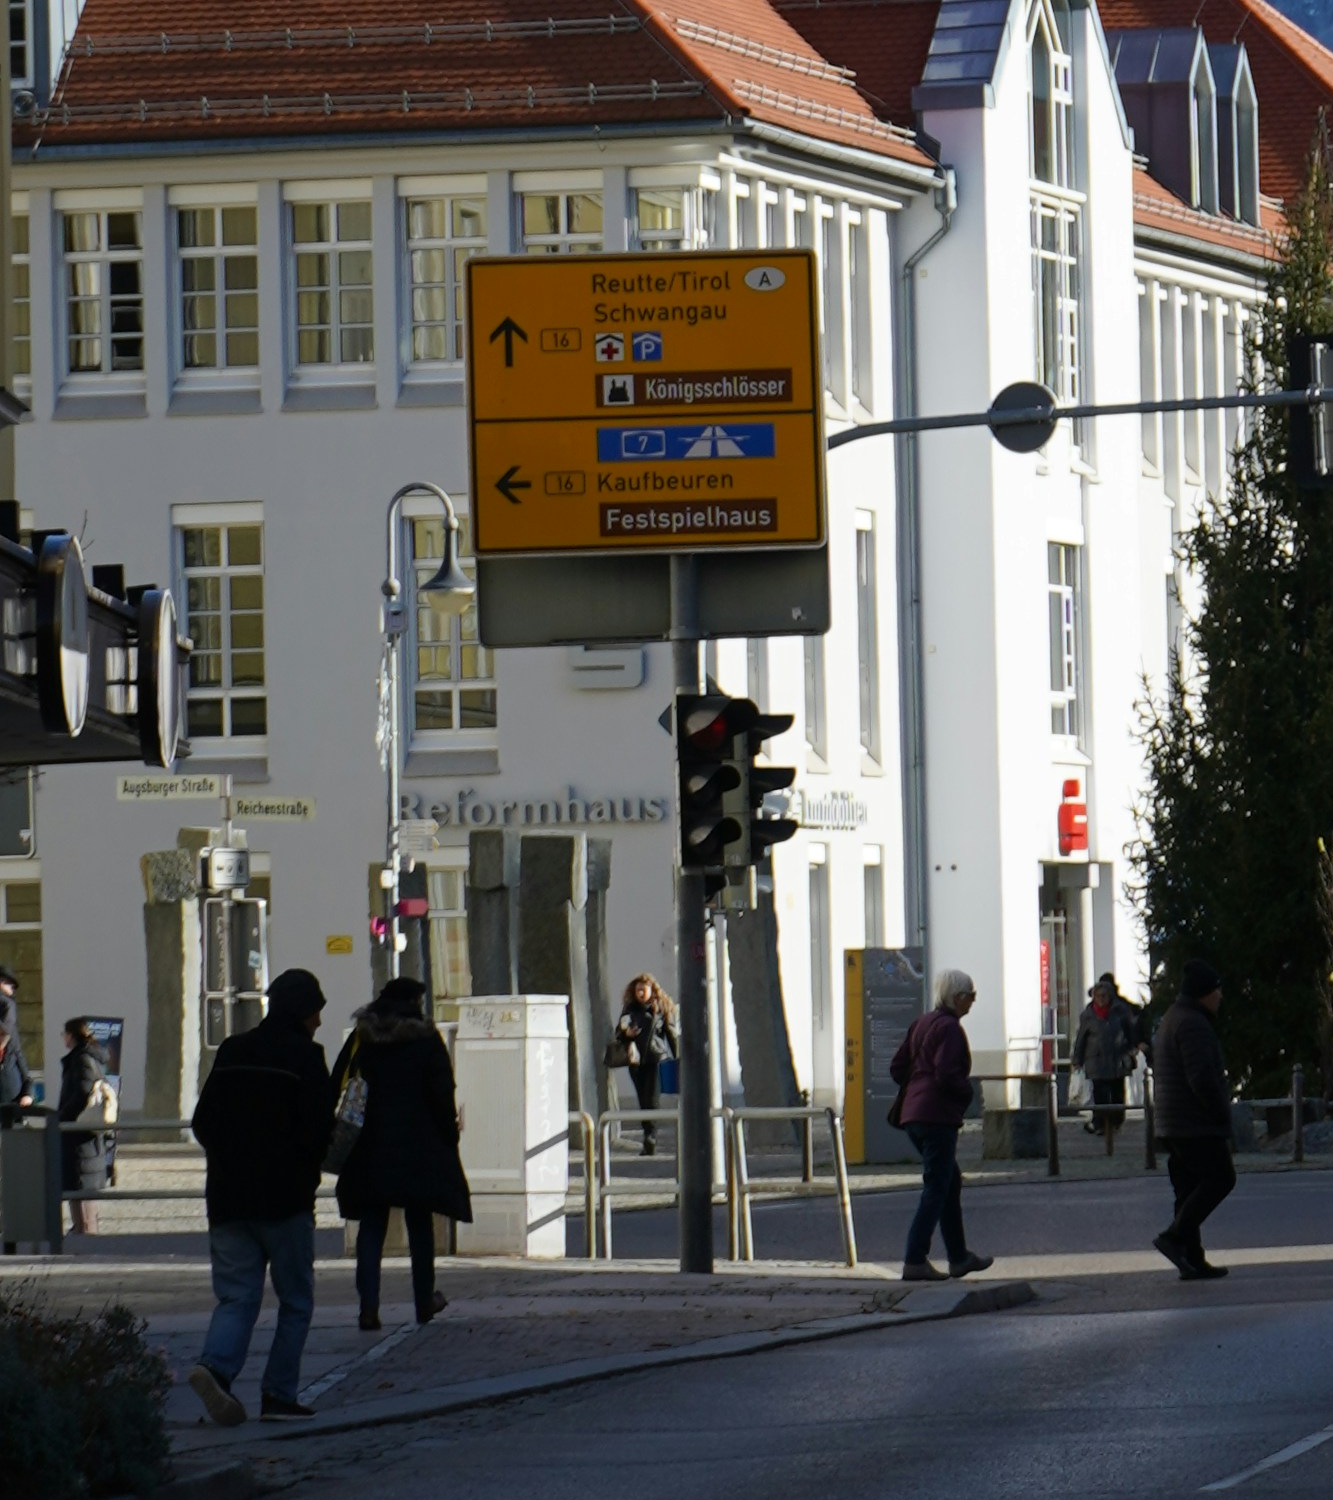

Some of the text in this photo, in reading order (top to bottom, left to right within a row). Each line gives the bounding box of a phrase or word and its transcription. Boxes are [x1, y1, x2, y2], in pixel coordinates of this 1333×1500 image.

[591, 271, 772, 294] Reutte/Tirol A
[594, 303, 727, 326] Schwangau
[552, 332, 570, 348] 16
[645, 375, 786, 403] Königsschlösser
[637, 435, 648, 453] 7
[557, 472, 734, 493] 16 Kaufbeuren
[606, 506, 772, 533] Festspielhaus
[122, 777, 215, 797] Augsburger Straße
[236, 800, 309, 817] Reichenstraße
[399, 785, 669, 827] Reformhaus
